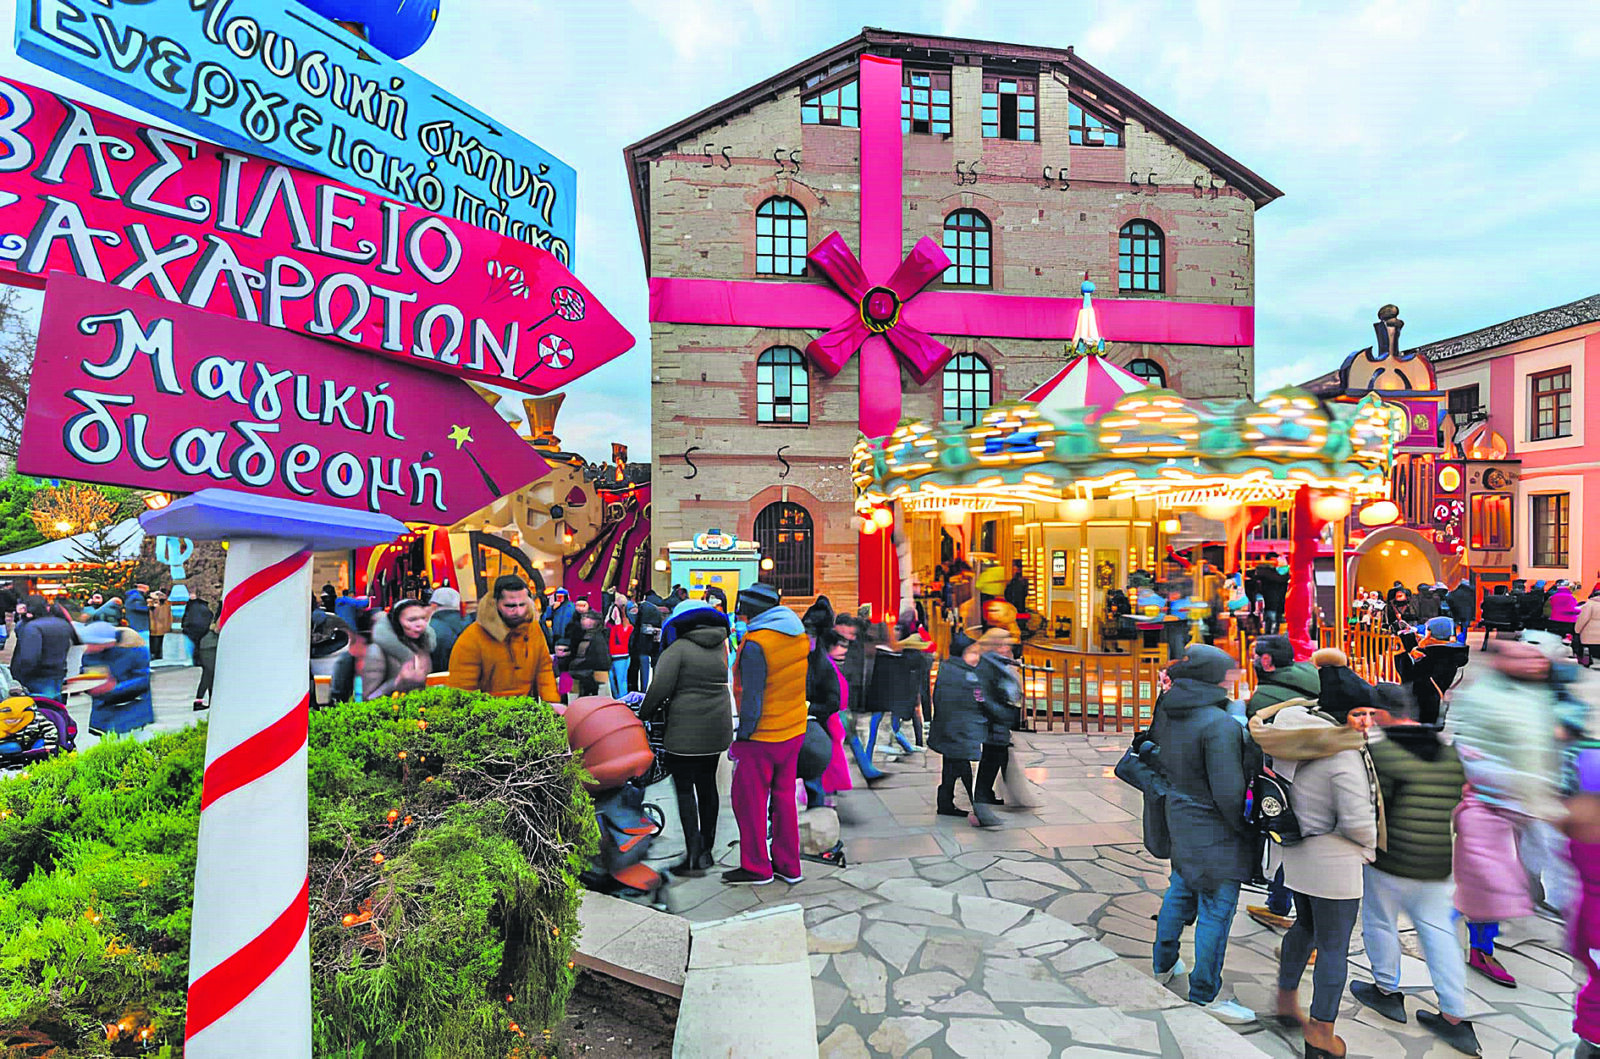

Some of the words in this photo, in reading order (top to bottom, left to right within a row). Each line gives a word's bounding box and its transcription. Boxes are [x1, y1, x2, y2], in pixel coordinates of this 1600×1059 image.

[418, 120, 556, 227] σκηνή
[80, 308, 405, 441] Μαγική
[64, 387, 448, 513] διαδρομή
